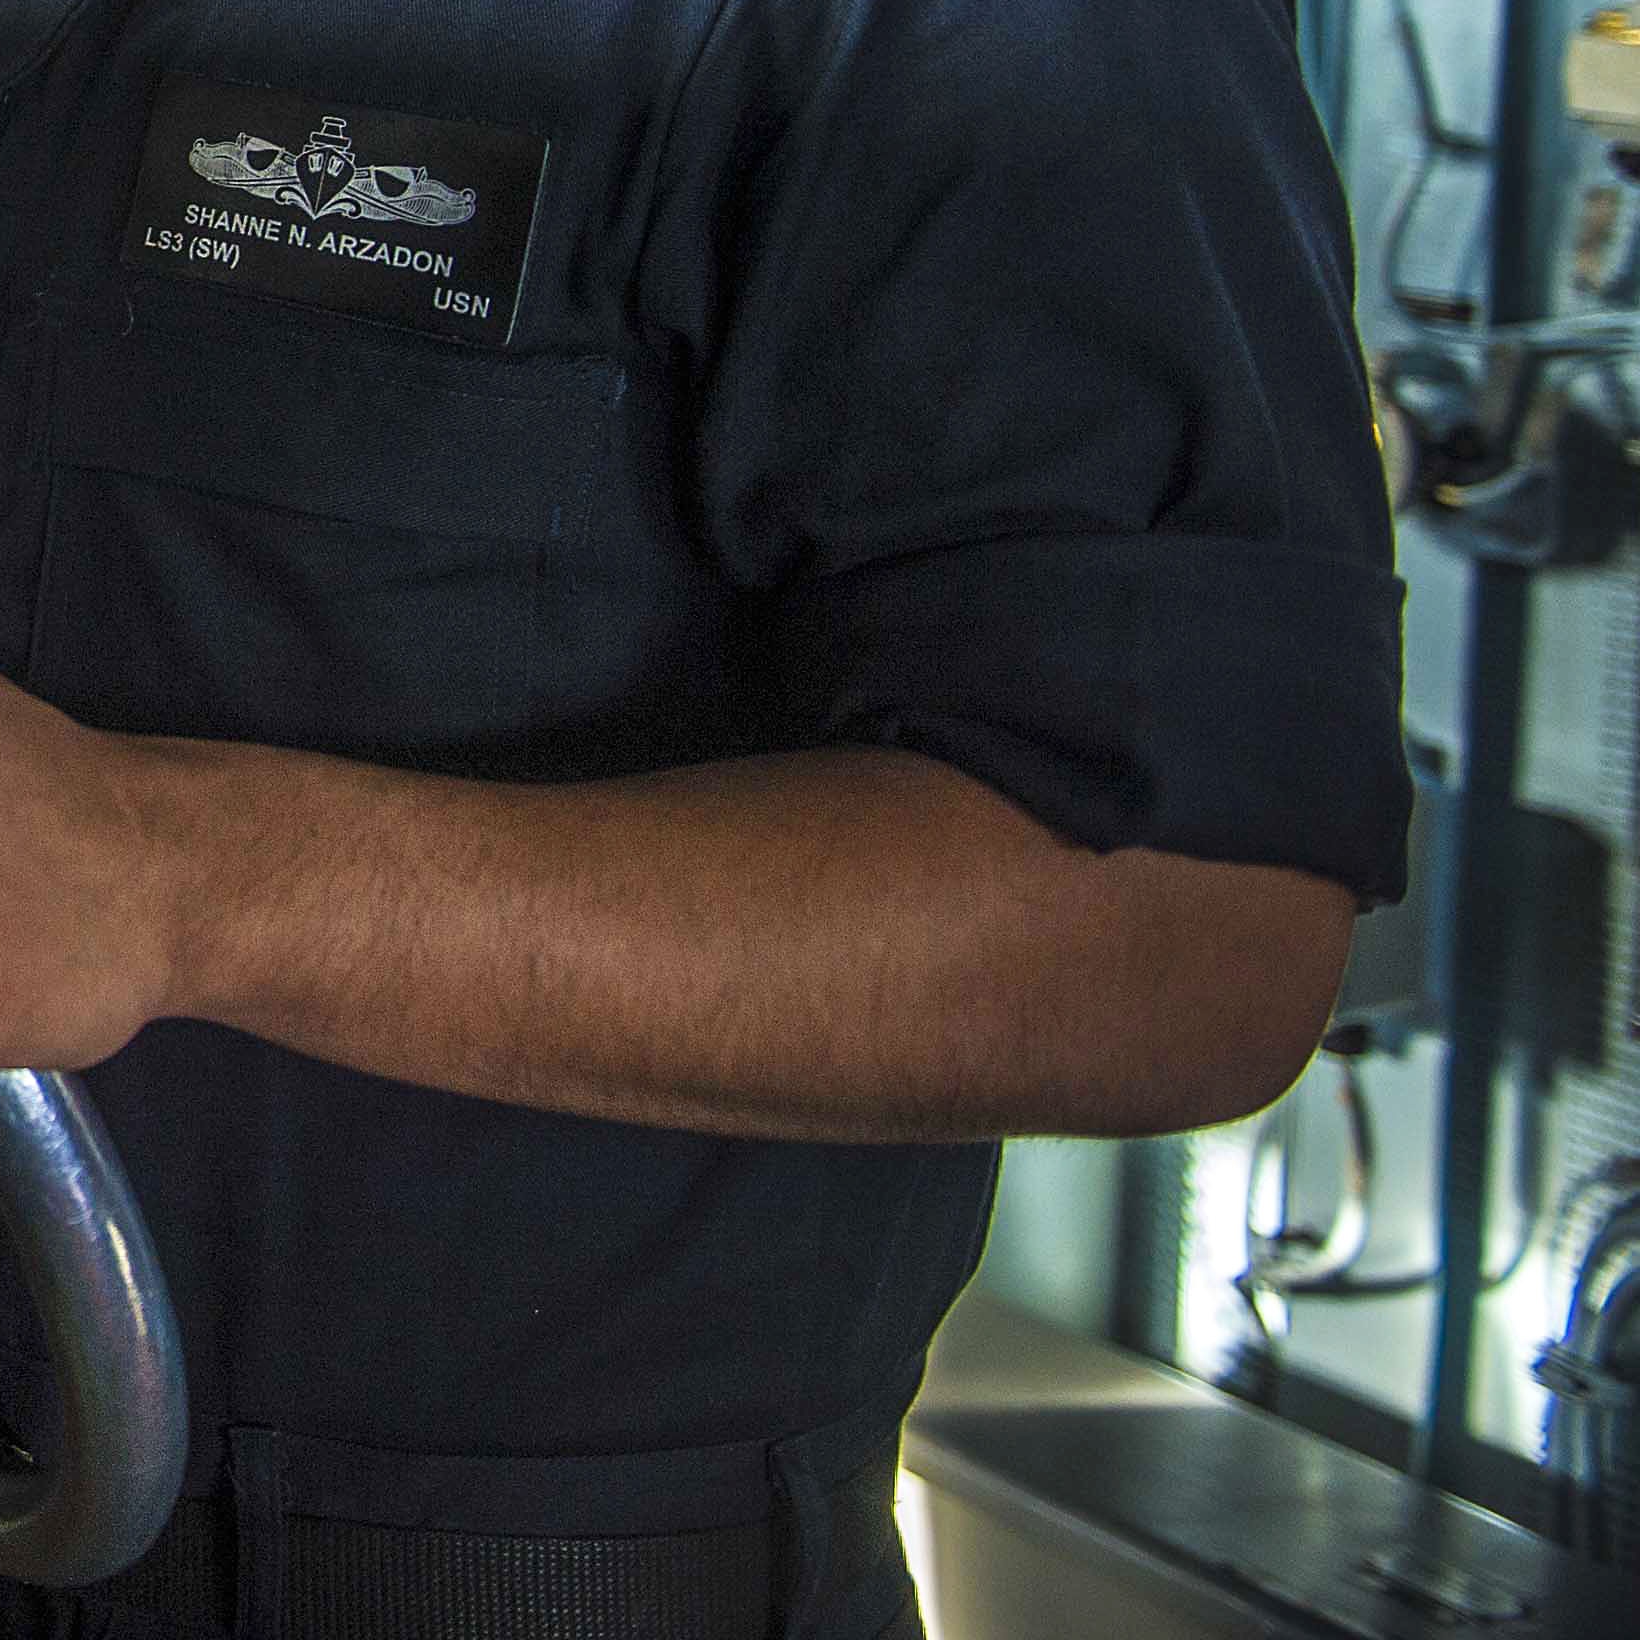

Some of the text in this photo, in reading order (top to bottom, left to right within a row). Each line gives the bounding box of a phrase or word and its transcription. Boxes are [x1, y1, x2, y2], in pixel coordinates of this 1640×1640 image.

[144, 226, 240, 270] LS3 (SW)
[183, 203, 454, 278] SHANNE N. ARZADON
[433, 286, 491, 319] USN
